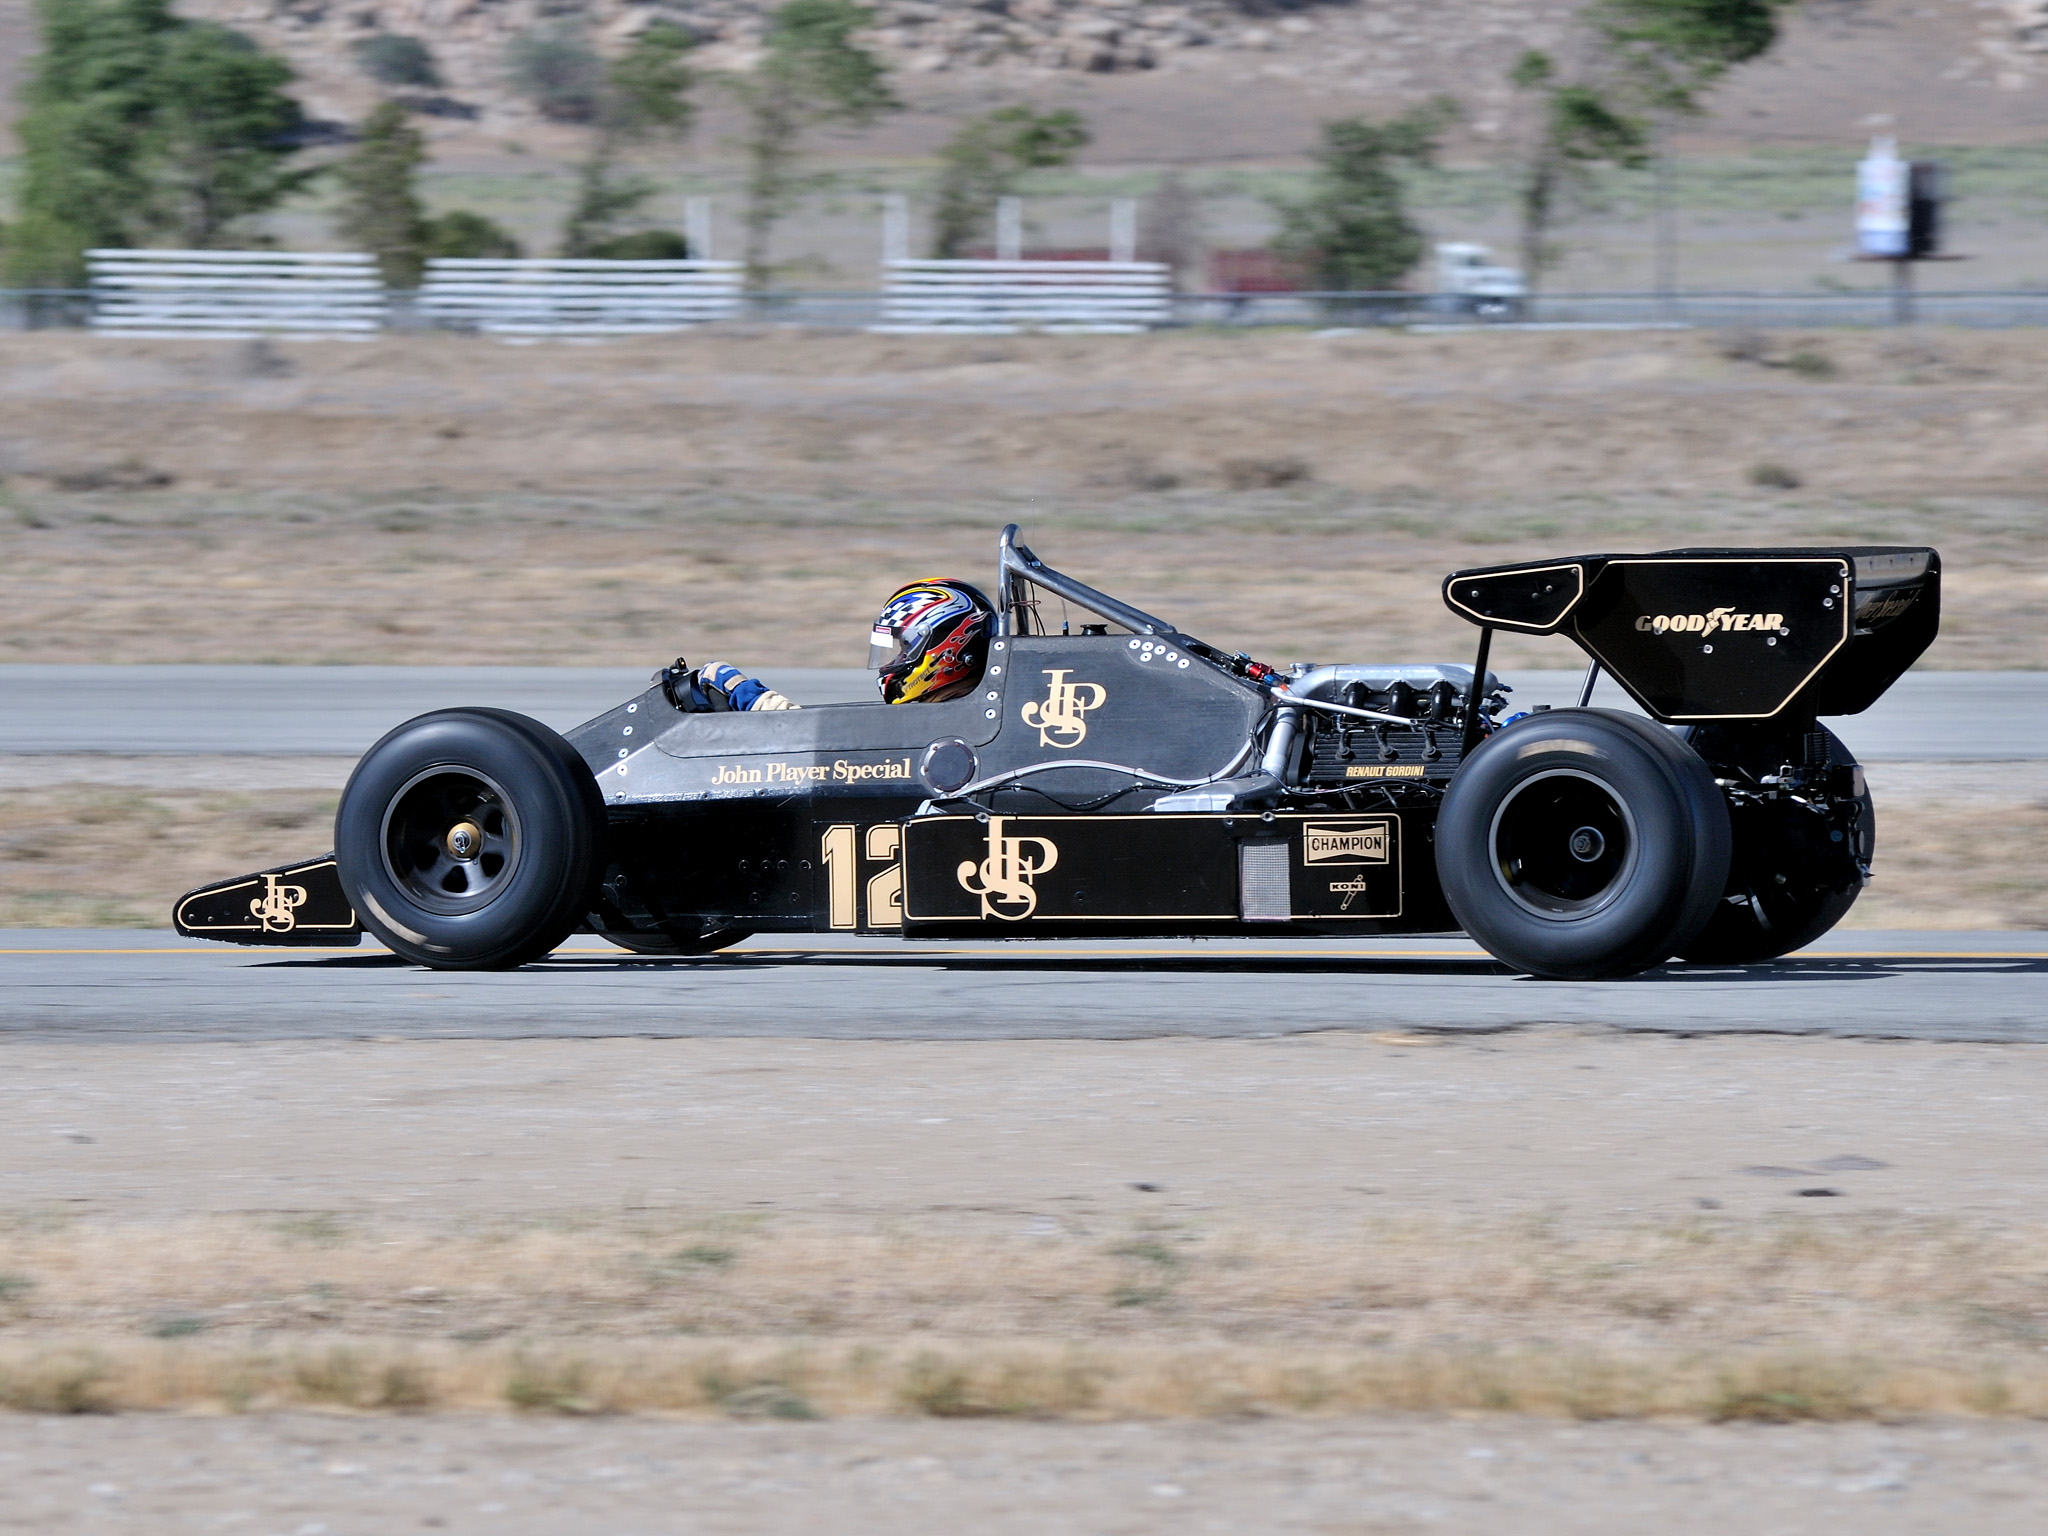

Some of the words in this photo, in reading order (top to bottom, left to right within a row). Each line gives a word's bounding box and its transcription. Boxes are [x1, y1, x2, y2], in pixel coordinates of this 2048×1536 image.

[712, 764, 762, 785] John
[766, 762, 830, 785] Player
[833, 758, 912, 785] Special
[1345, 766, 1386, 777] RENAULT
[1385, 765, 1425, 777] GORDINI
[1311, 836, 1383, 852] CHAMPION
[822, 824, 902, 930] 12
